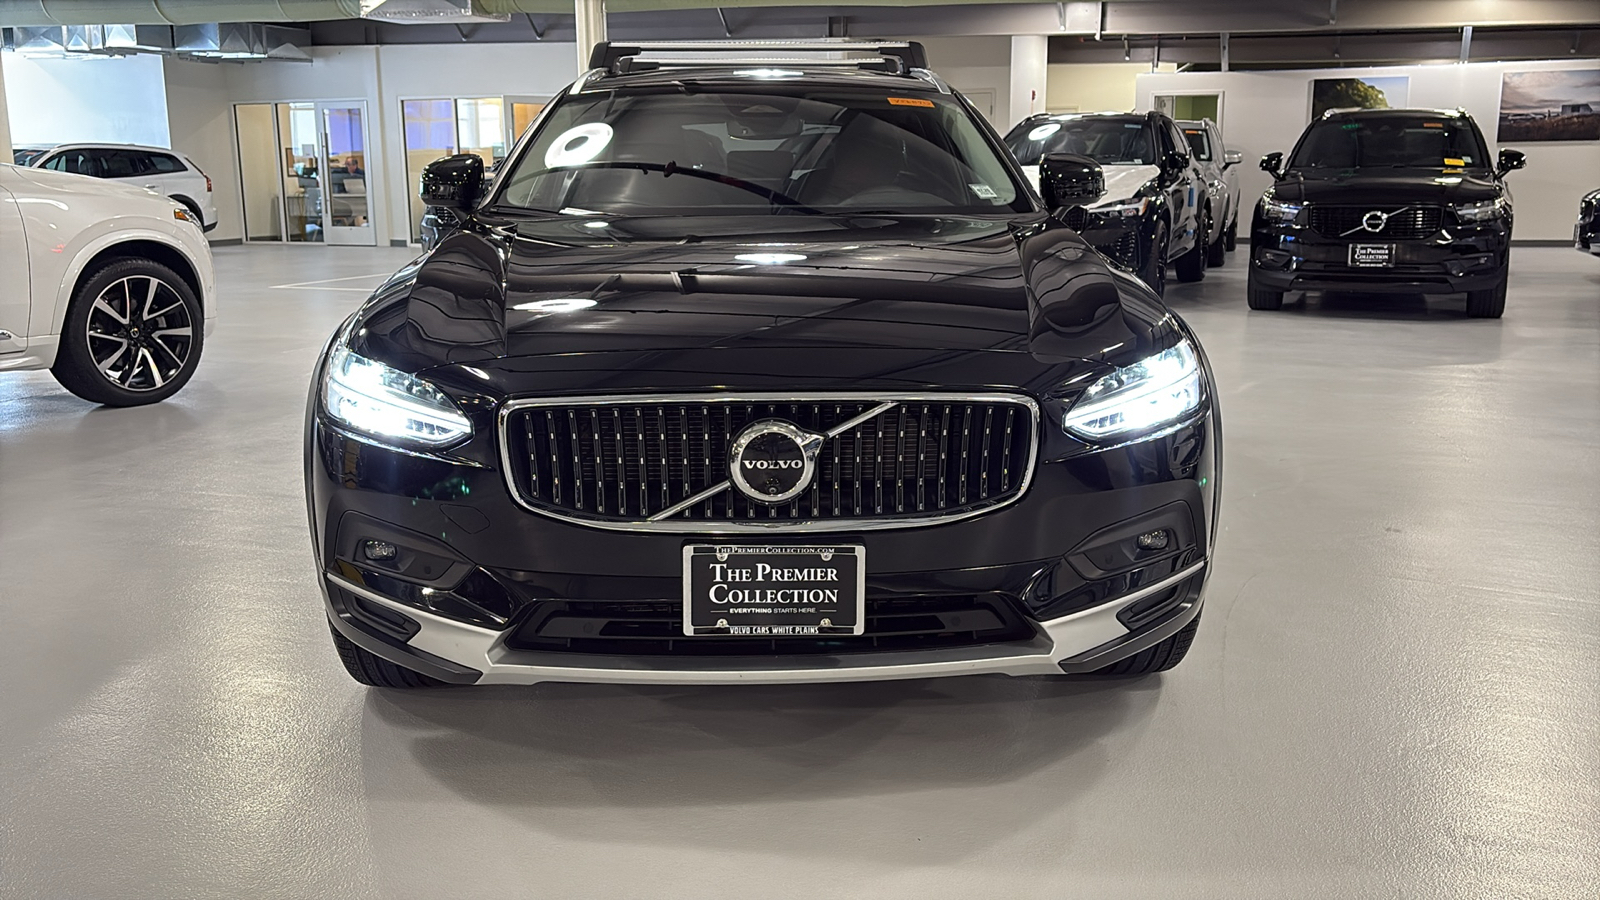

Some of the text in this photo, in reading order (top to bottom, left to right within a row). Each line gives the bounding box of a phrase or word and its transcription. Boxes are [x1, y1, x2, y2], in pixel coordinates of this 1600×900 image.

[742, 459, 803, 470] VOLVO
[729, 626, 819, 634] VOLVO CARS WHITE PLAINS
